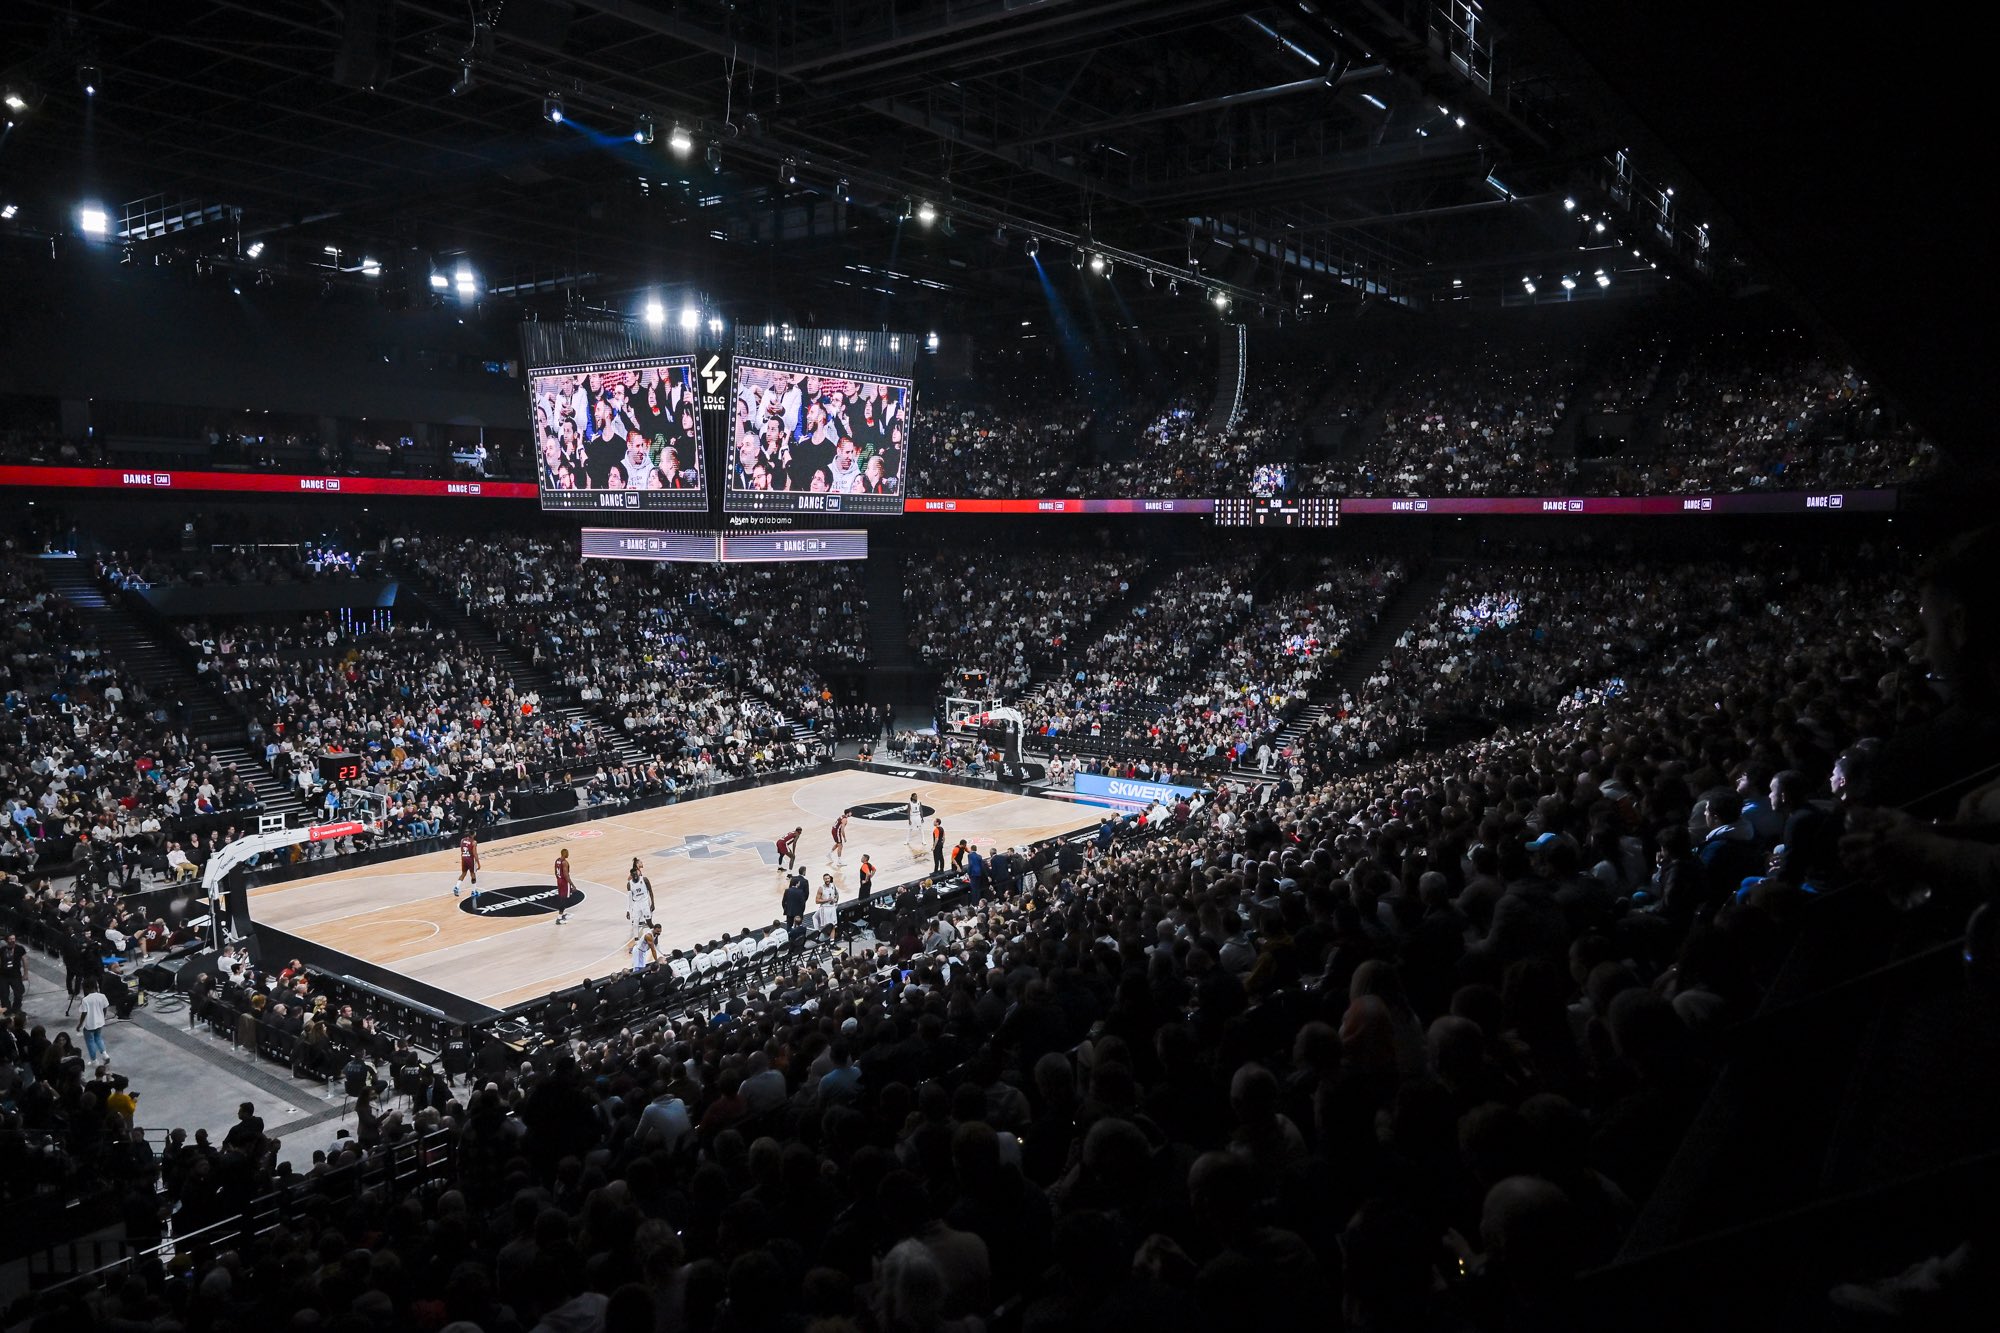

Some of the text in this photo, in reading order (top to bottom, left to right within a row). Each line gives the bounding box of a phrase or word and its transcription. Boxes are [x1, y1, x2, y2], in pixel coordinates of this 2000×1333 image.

[703, 396, 725, 404] LDLC
[124, 474, 151, 484] DANCE
[301, 480, 324, 489] DANCE
[448, 484, 468, 492] DANCE
[600, 493, 624, 506] DANCE
[798, 496, 824, 509] DANCE
[1806, 496, 1828, 507] DANCE
[1038, 502, 1054, 510] DANCE
[1145, 502, 1162, 510] DANCE
[1392, 502, 1413, 510] DANCE
[1543, 501, 1567, 510] DANCE
[1684, 500, 1700, 509] DANCE
[729, 516, 792, 525] Absen by alabama
[627, 539, 646, 549] DANCE
[784, 540, 805, 551] DANCE
[339, 765, 357, 779] 23
[1108, 780, 1174, 803] SKWEEK
